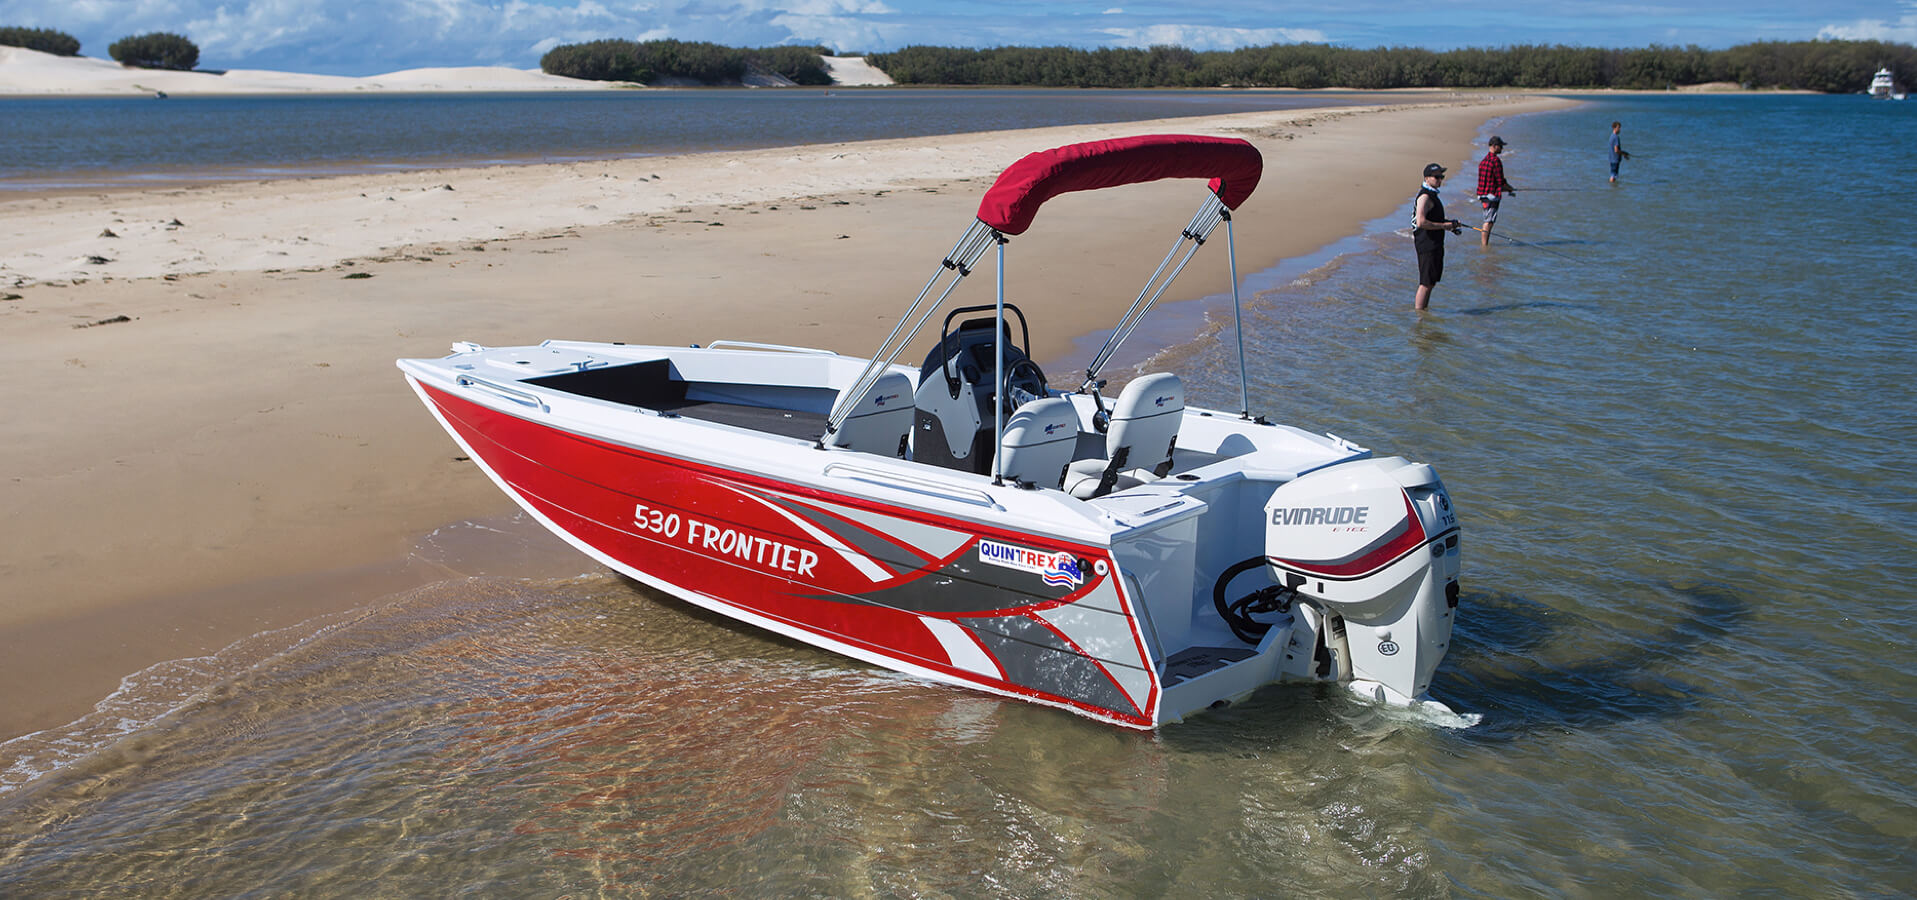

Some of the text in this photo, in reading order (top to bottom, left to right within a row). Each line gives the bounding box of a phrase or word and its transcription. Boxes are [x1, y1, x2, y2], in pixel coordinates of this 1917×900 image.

[1272, 507, 1369, 525] EVINRUDE
[633, 504, 818, 578] 530 FRONTIER
[981, 542, 1057, 570] QUINTREX
